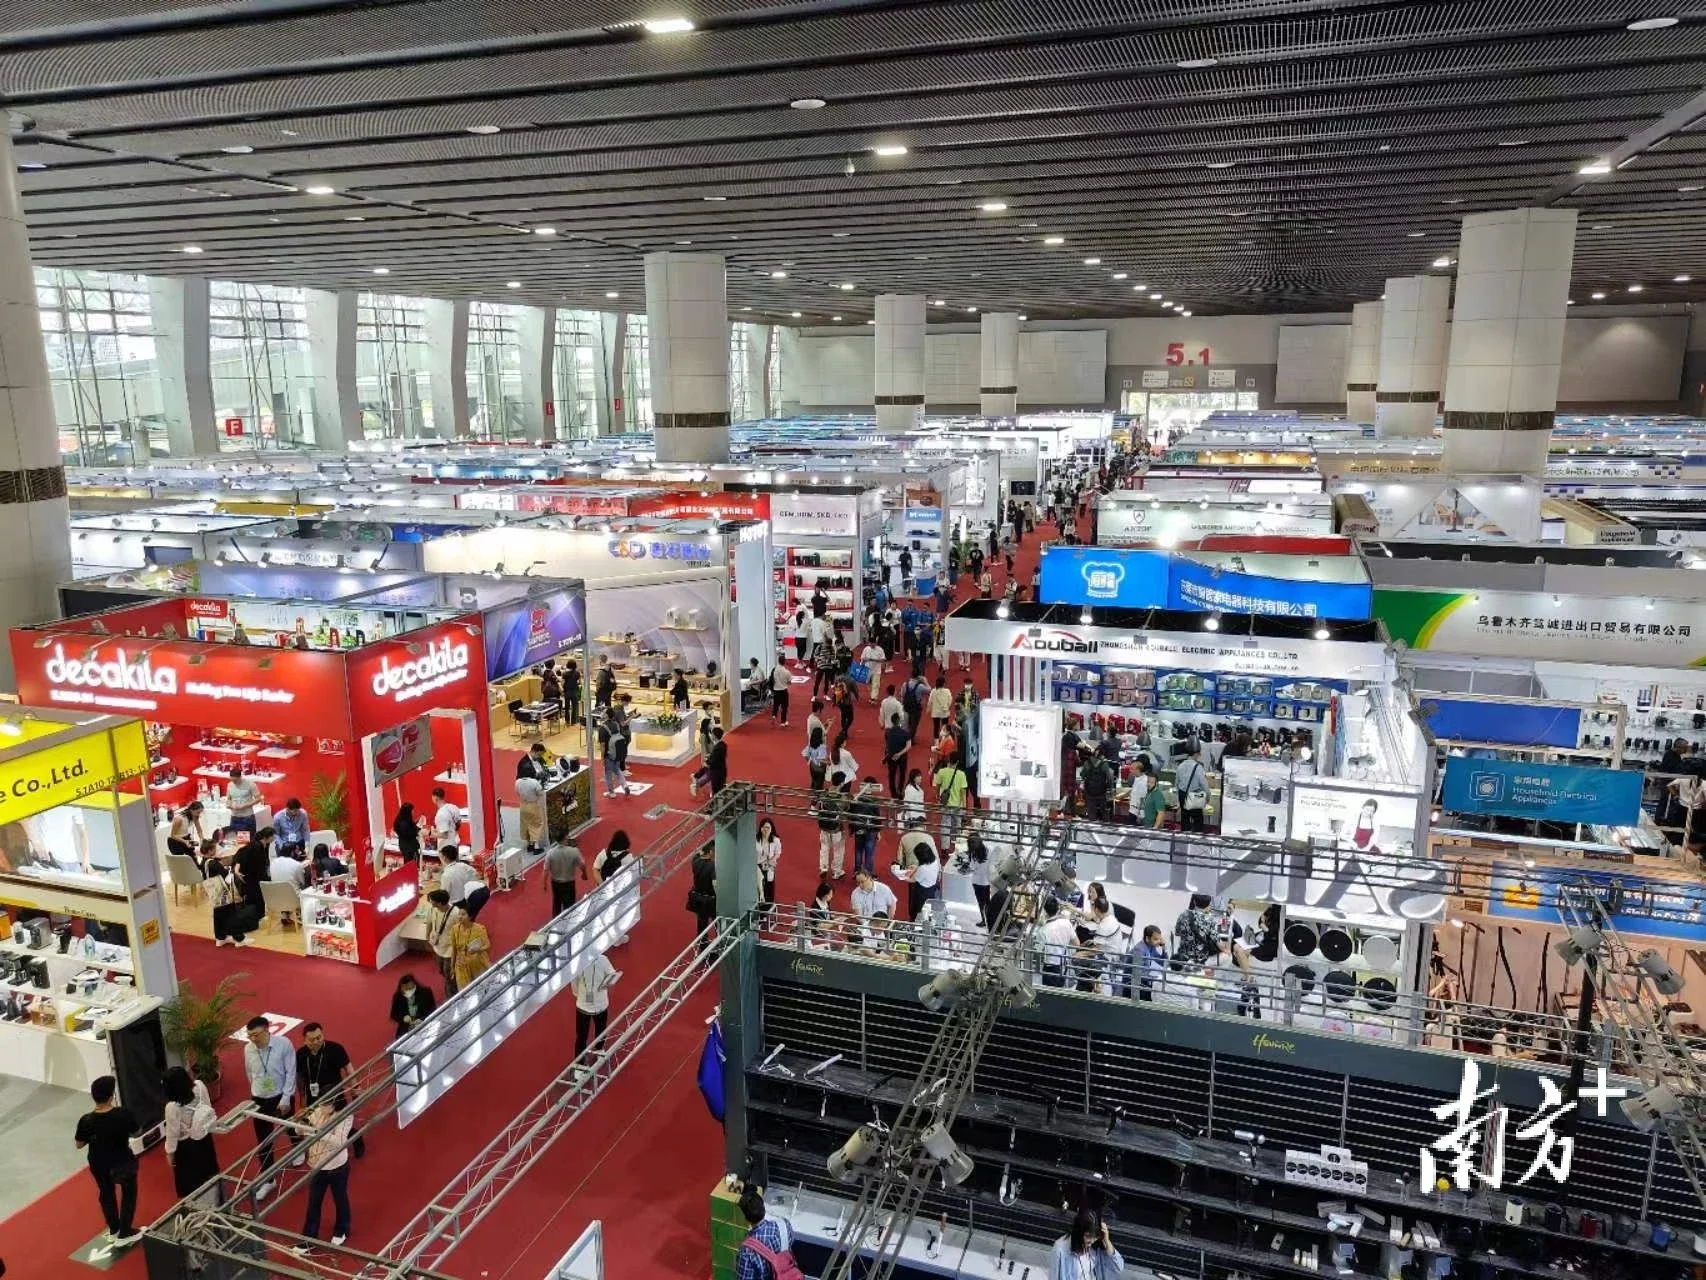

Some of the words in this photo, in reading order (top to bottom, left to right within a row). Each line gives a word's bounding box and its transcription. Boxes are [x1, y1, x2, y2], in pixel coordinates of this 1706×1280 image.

[1166, 342, 1211, 367] 5.1
[230, 419, 240, 434] F
[46, 643, 177, 694] decakila
[373, 636, 469, 696] decakila
[12, 758, 89, 798] Co.,Ltd.
